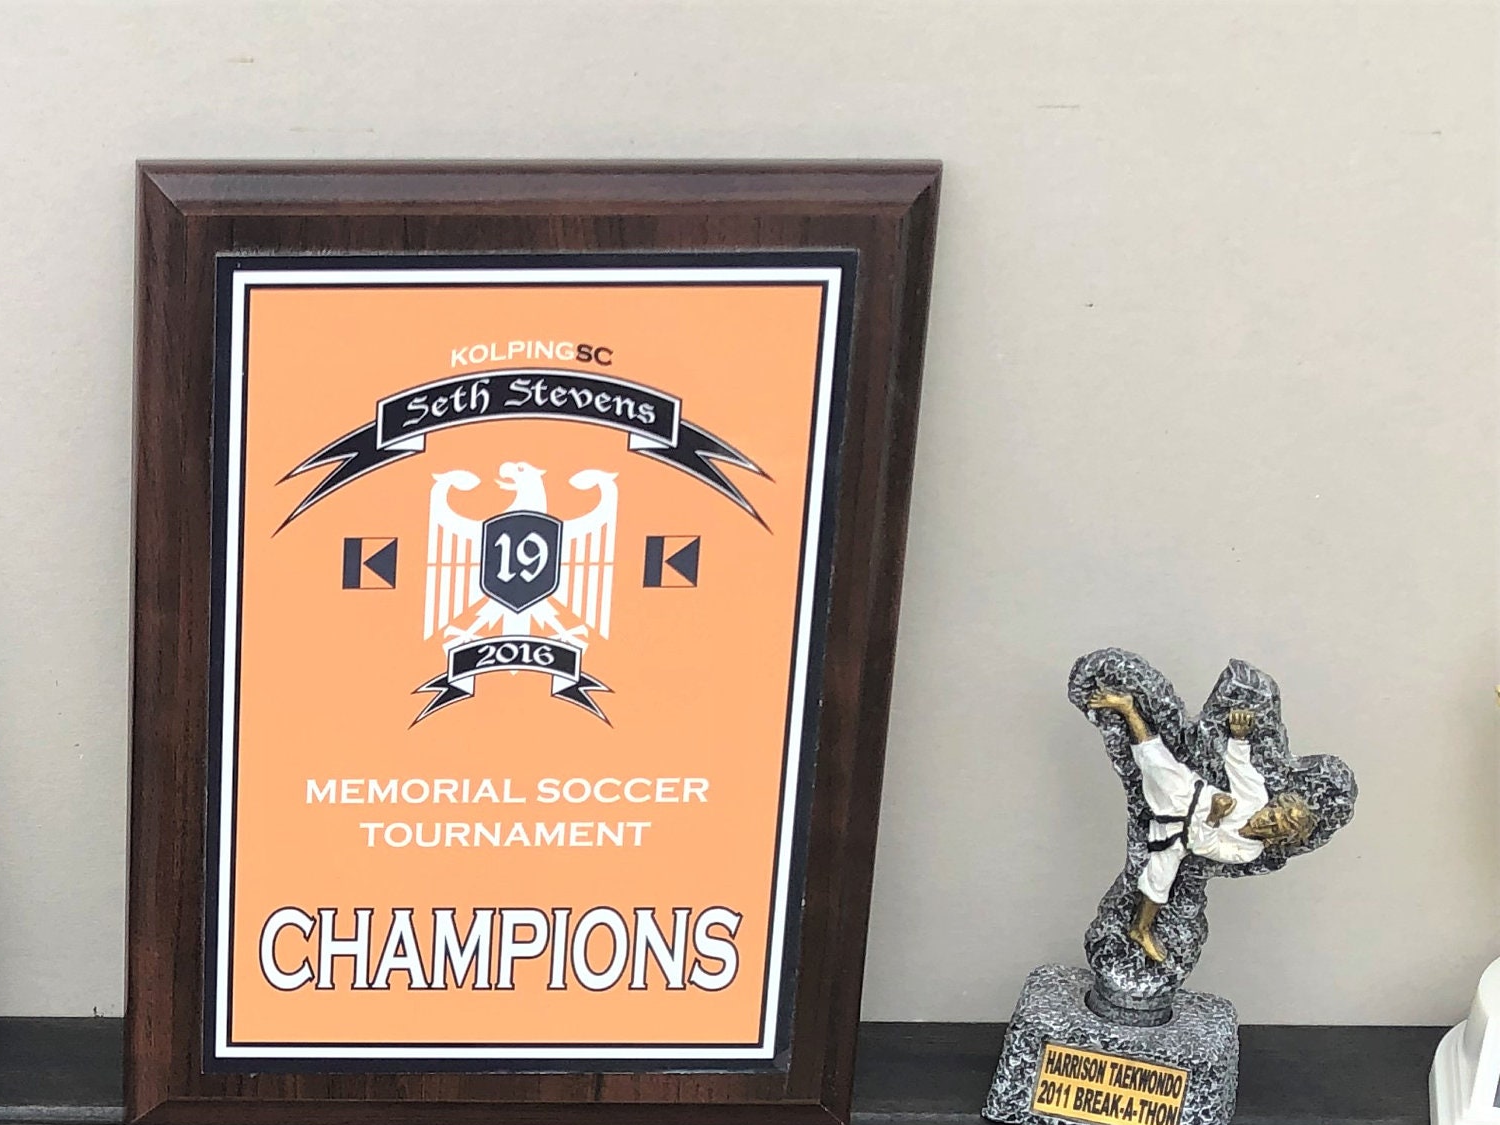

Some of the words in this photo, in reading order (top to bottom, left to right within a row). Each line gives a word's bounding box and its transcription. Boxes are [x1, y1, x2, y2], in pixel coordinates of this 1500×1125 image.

[402, 377, 491, 428] Seth
[503, 377, 656, 425] Stevens
[493, 531, 550, 585] 19
[476, 643, 554, 667] 2016
[305, 778, 526, 804] MEMORIAL
[536, 776, 710, 803] SOCCER
[360, 822, 652, 848] TOURNAMENT
[258, 905, 743, 992] CHAMPIONS
[1045, 1050, 1105, 1085] HARRISON
[1109, 1063, 1183, 1099] TAEKWONDO
[1037, 1080, 1070, 1108] 2011
